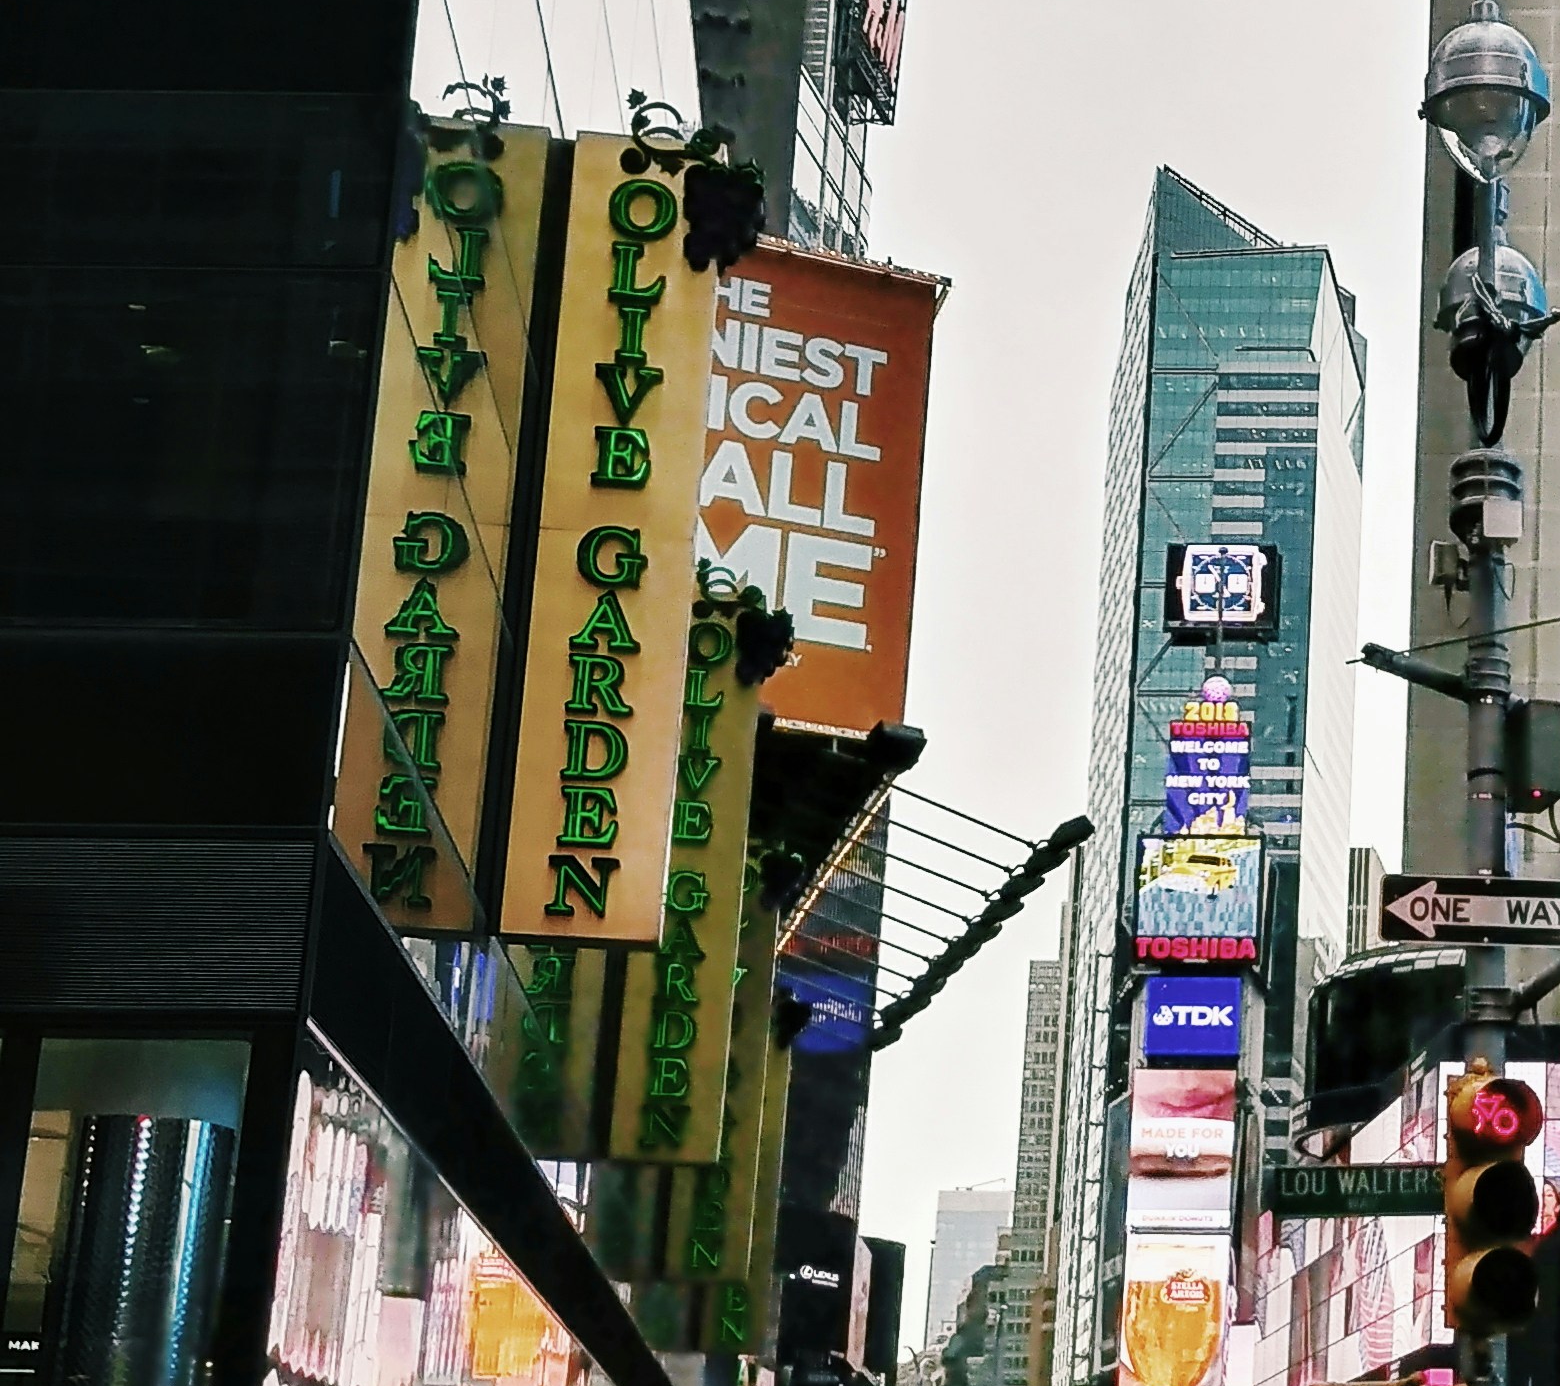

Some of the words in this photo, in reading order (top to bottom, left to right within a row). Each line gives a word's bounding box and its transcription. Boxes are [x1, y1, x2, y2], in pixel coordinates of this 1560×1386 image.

[715, 277, 772, 318] HE
[589, 178, 678, 489] OLIVE
[712, 319, 888, 396] NIEST
[707, 375, 881, 462] ICAL
[544, 524, 649, 918] GARDEN
[1184, 701, 1239, 722] 2018
[673, 622, 732, 845] OLIVE
[1171, 722, 1249, 736] TOSHIBA
[1170, 740, 1249, 754] WELCOME
[1197, 758, 1221, 771] TO
[1165, 775, 1204, 788] NEW
[1205, 775, 1251, 788] YORK
[1187, 793, 1228, 805] CITY
[1409, 897, 1471, 924] ONE
[1135, 936, 1258, 960] TOSHIBA
[1173, 1003, 1234, 1027] TDK
[1141, 1127, 1186, 1139] MADE
[1192, 1127, 1224, 1139] FOR
[1164, 1143, 1200, 1158] YOU
[1282, 1170, 1327, 1196] LOU
[1336, 1167, 1446, 1195] WALTERS
